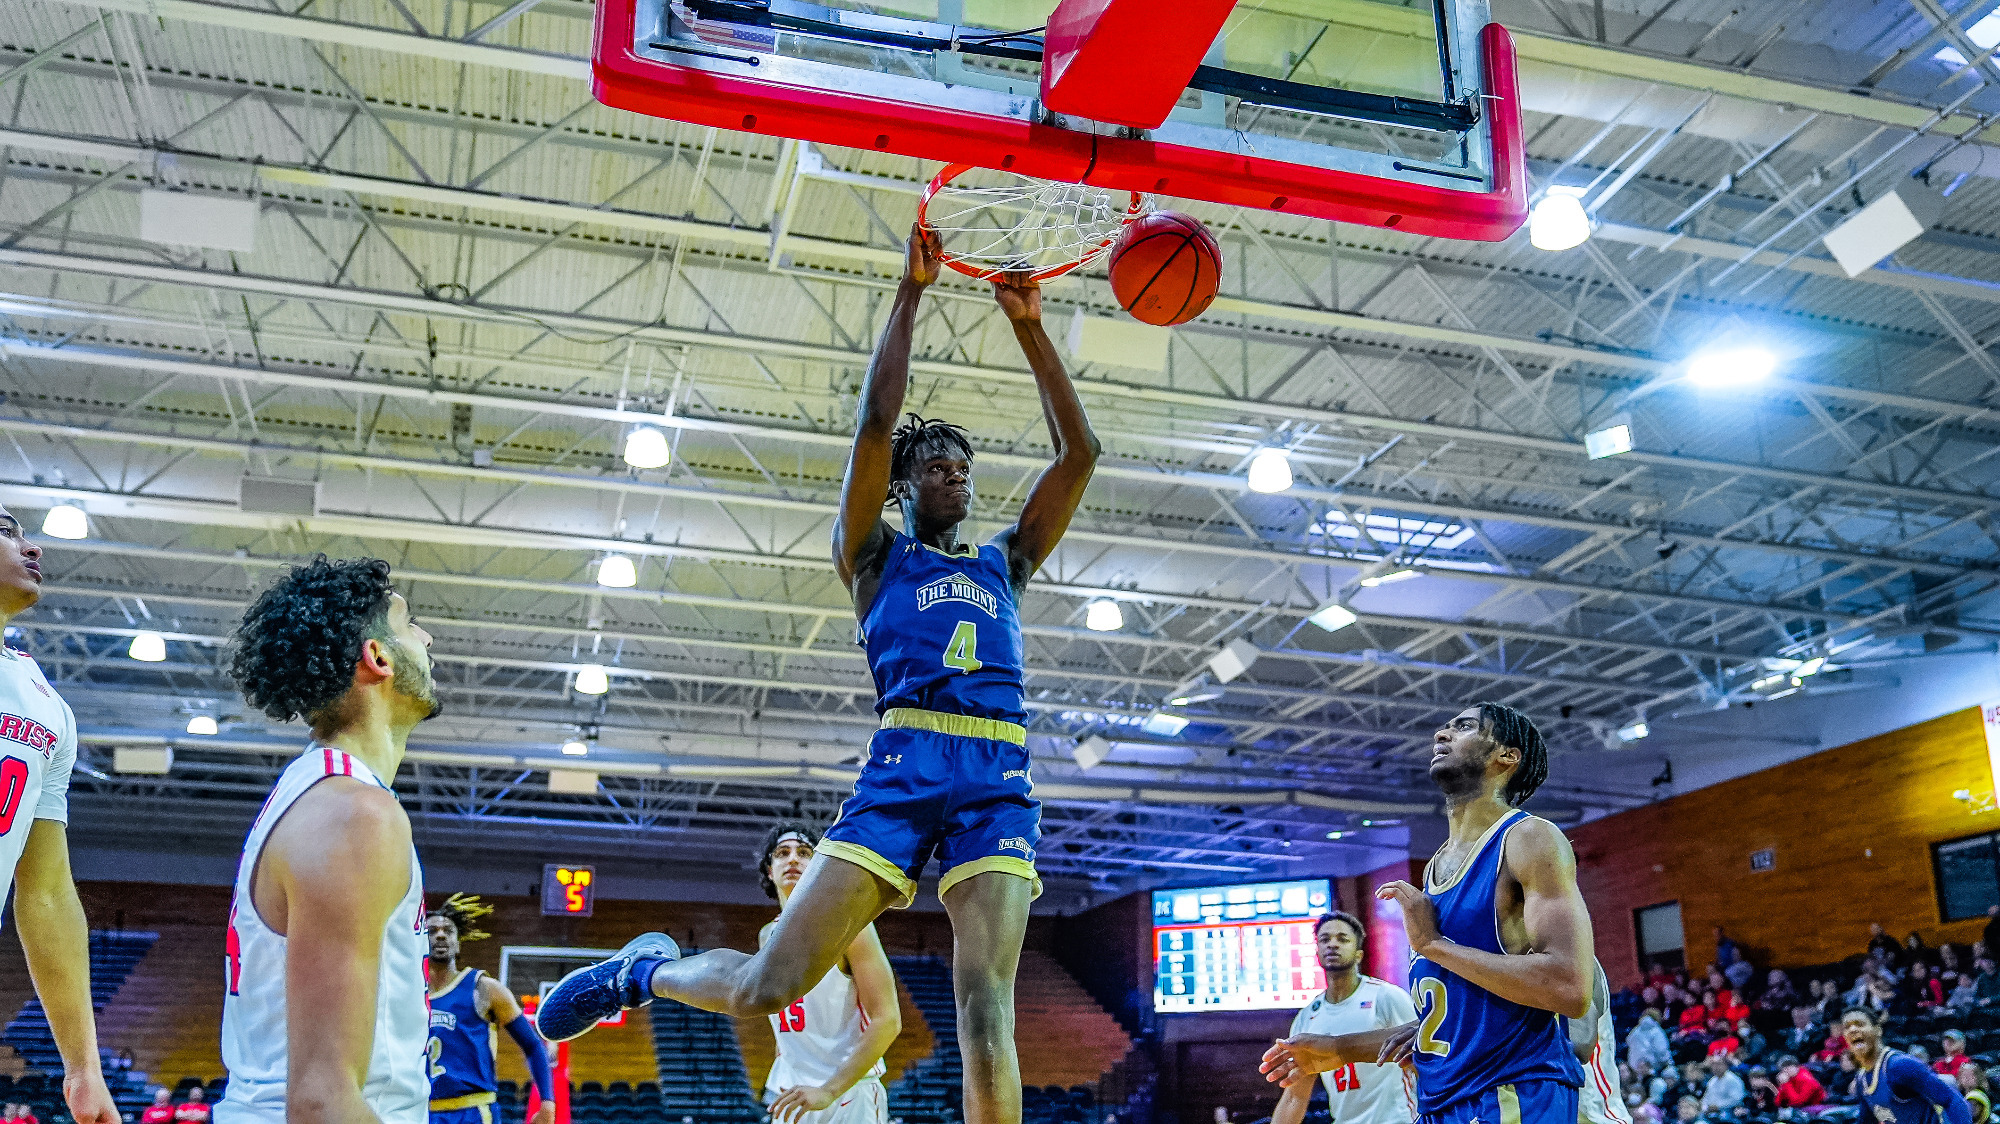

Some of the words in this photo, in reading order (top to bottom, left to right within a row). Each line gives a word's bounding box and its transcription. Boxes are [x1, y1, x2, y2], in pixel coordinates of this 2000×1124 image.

[920, 583, 948, 606] THE
[951, 583, 996, 614] MOUNT
[943, 620, 982, 675] 4
[565, 883, 585, 912] 5
